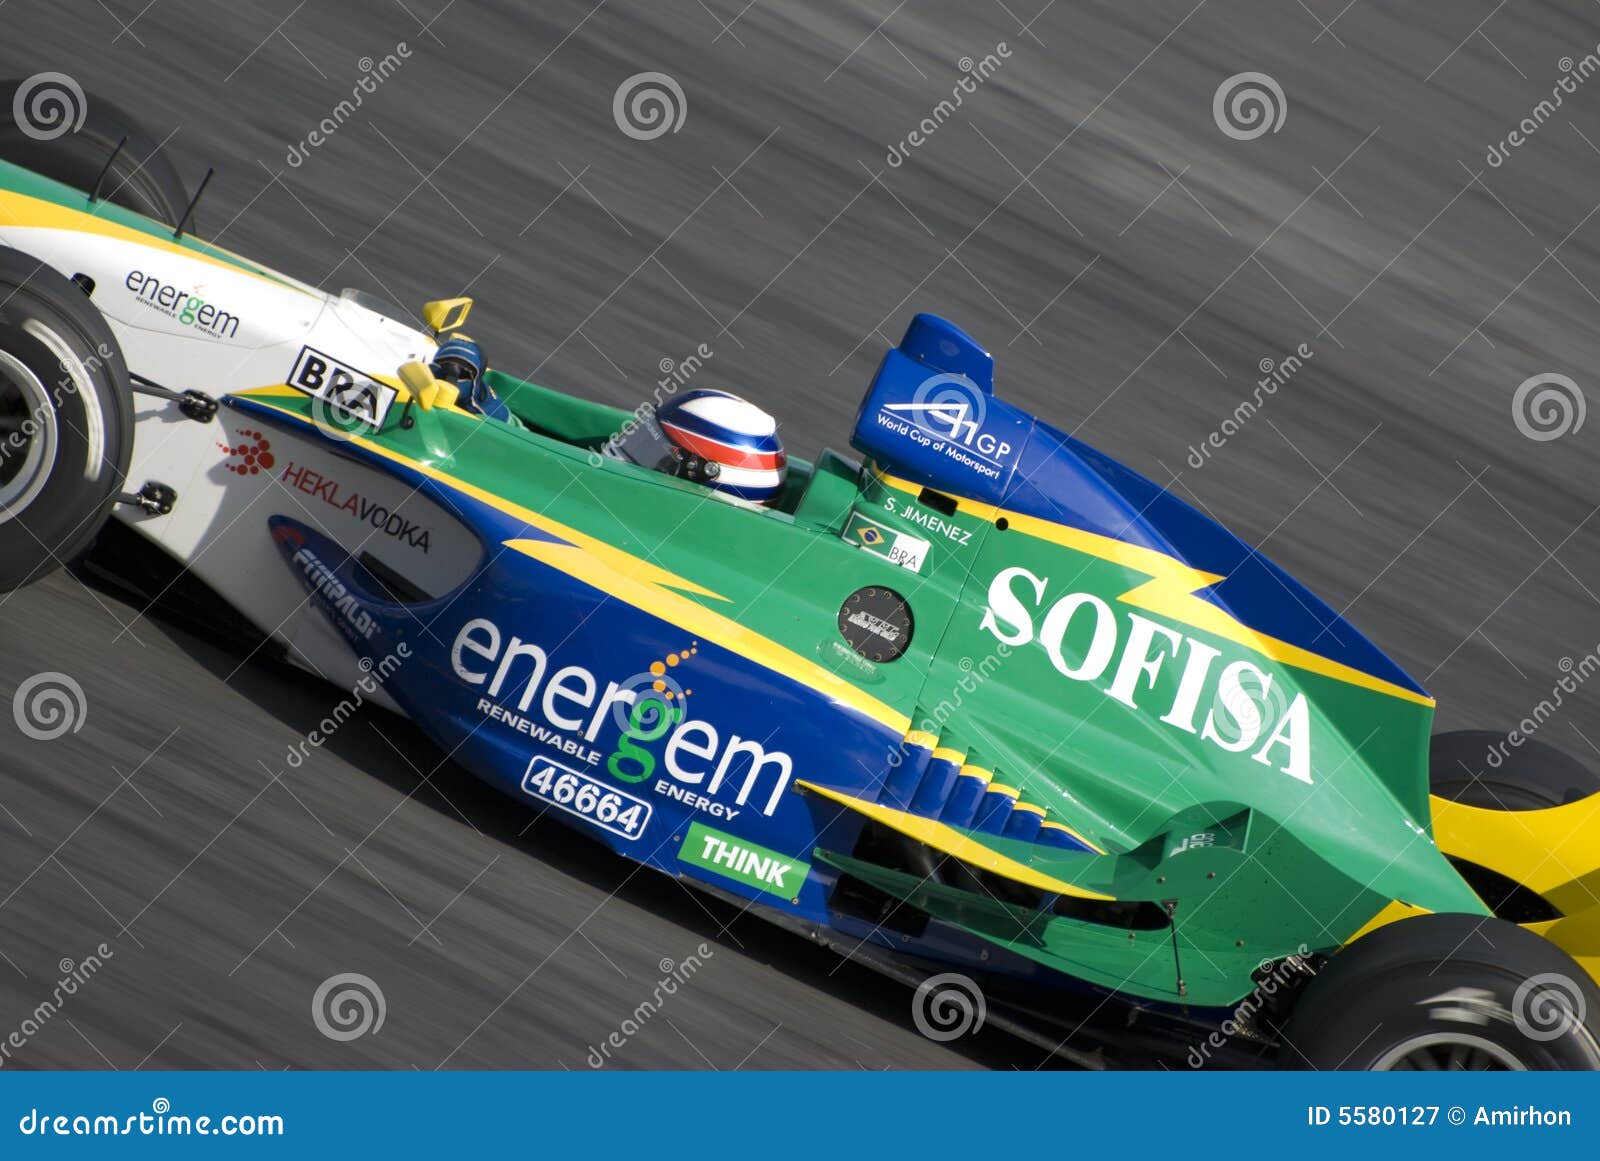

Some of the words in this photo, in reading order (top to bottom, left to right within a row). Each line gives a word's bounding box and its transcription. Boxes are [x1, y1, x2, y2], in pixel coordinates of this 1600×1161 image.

[125, 270, 240, 338] energem
[299, 356, 383, 421] BRA
[877, 413, 910, 436] World
[909, 429, 931, 446] Cup
[932, 441, 946, 453] of
[945, 446, 1000, 480] Motorsport
[884, 497, 896, 513] S.
[900, 504, 972, 546] JIMENEZ
[889, 546, 917, 569] BRA
[979, 566, 1314, 785] SOFISA
[451, 617, 793, 817] energem
[477, 698, 602, 766] RENEWABLE
[530, 766, 644, 833] 46664
[654, 781, 740, 822] ENERGY
[701, 835, 792, 888] THINK
